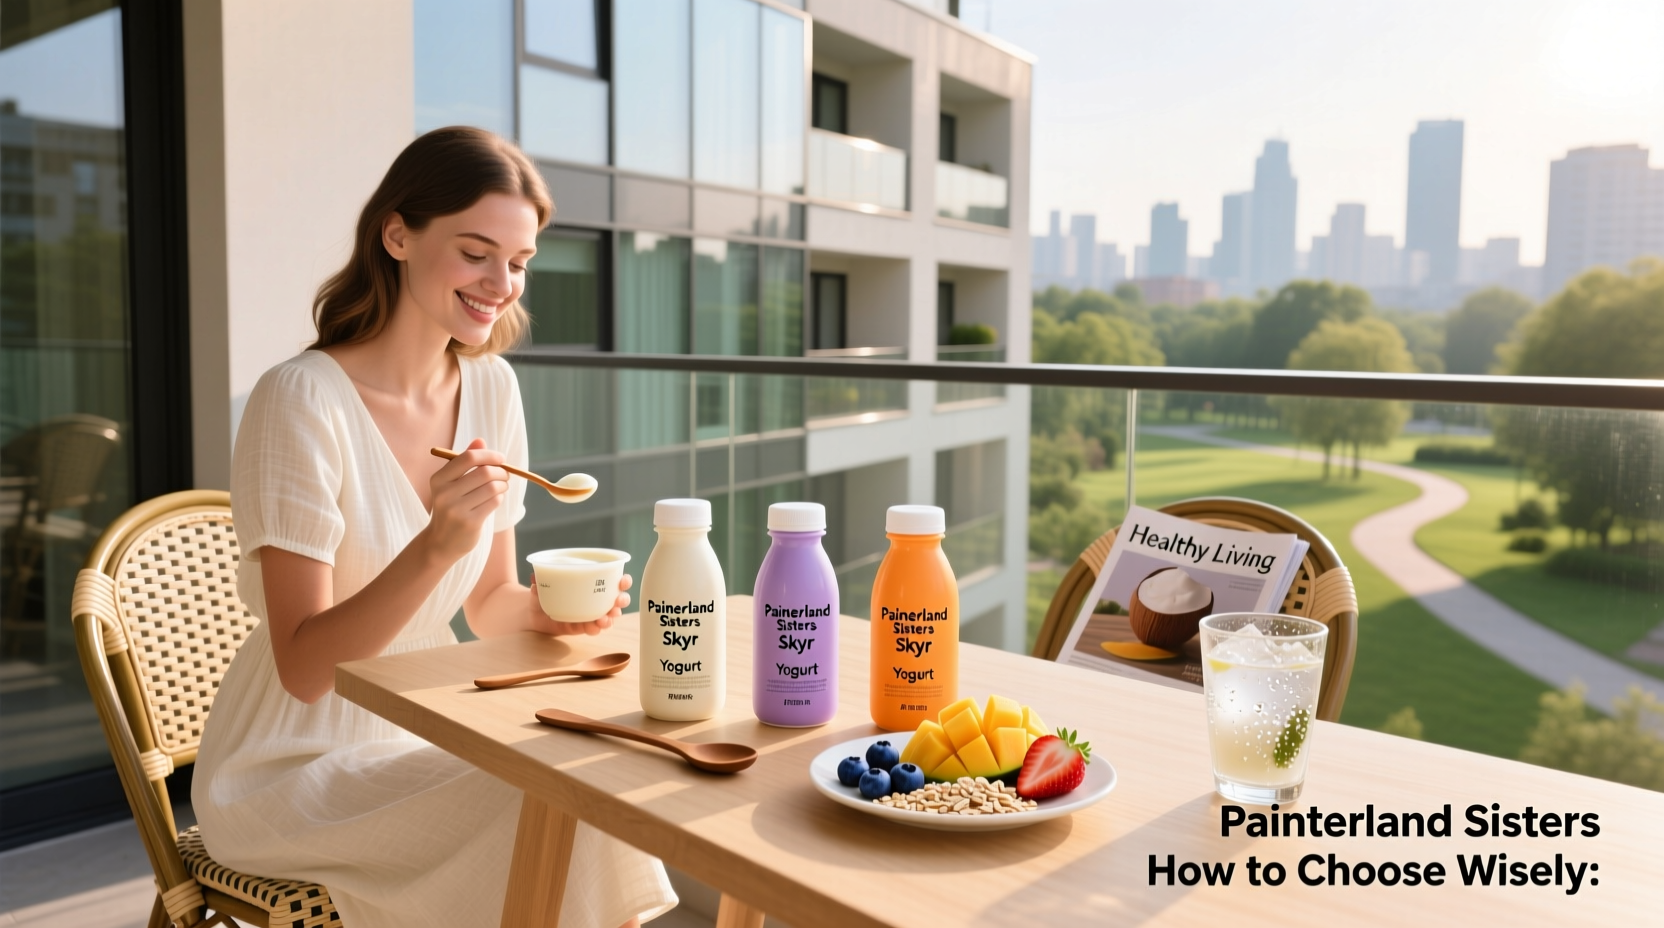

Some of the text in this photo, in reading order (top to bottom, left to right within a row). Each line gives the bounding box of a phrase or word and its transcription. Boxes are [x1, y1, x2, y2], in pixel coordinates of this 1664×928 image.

[1129, 524, 1276, 574] Healthy Living
[660, 615, 700, 627] Sisters
[776, 619, 817, 631] Sisters
[662, 630, 699, 651] Skyr
[778, 634, 815, 655] Skyr
[895, 637, 932, 658] Skyr
[659, 659, 702, 675] Yogurt
[776, 662, 819, 679] Yogurt
[892, 666, 935, 683] Yogurt
